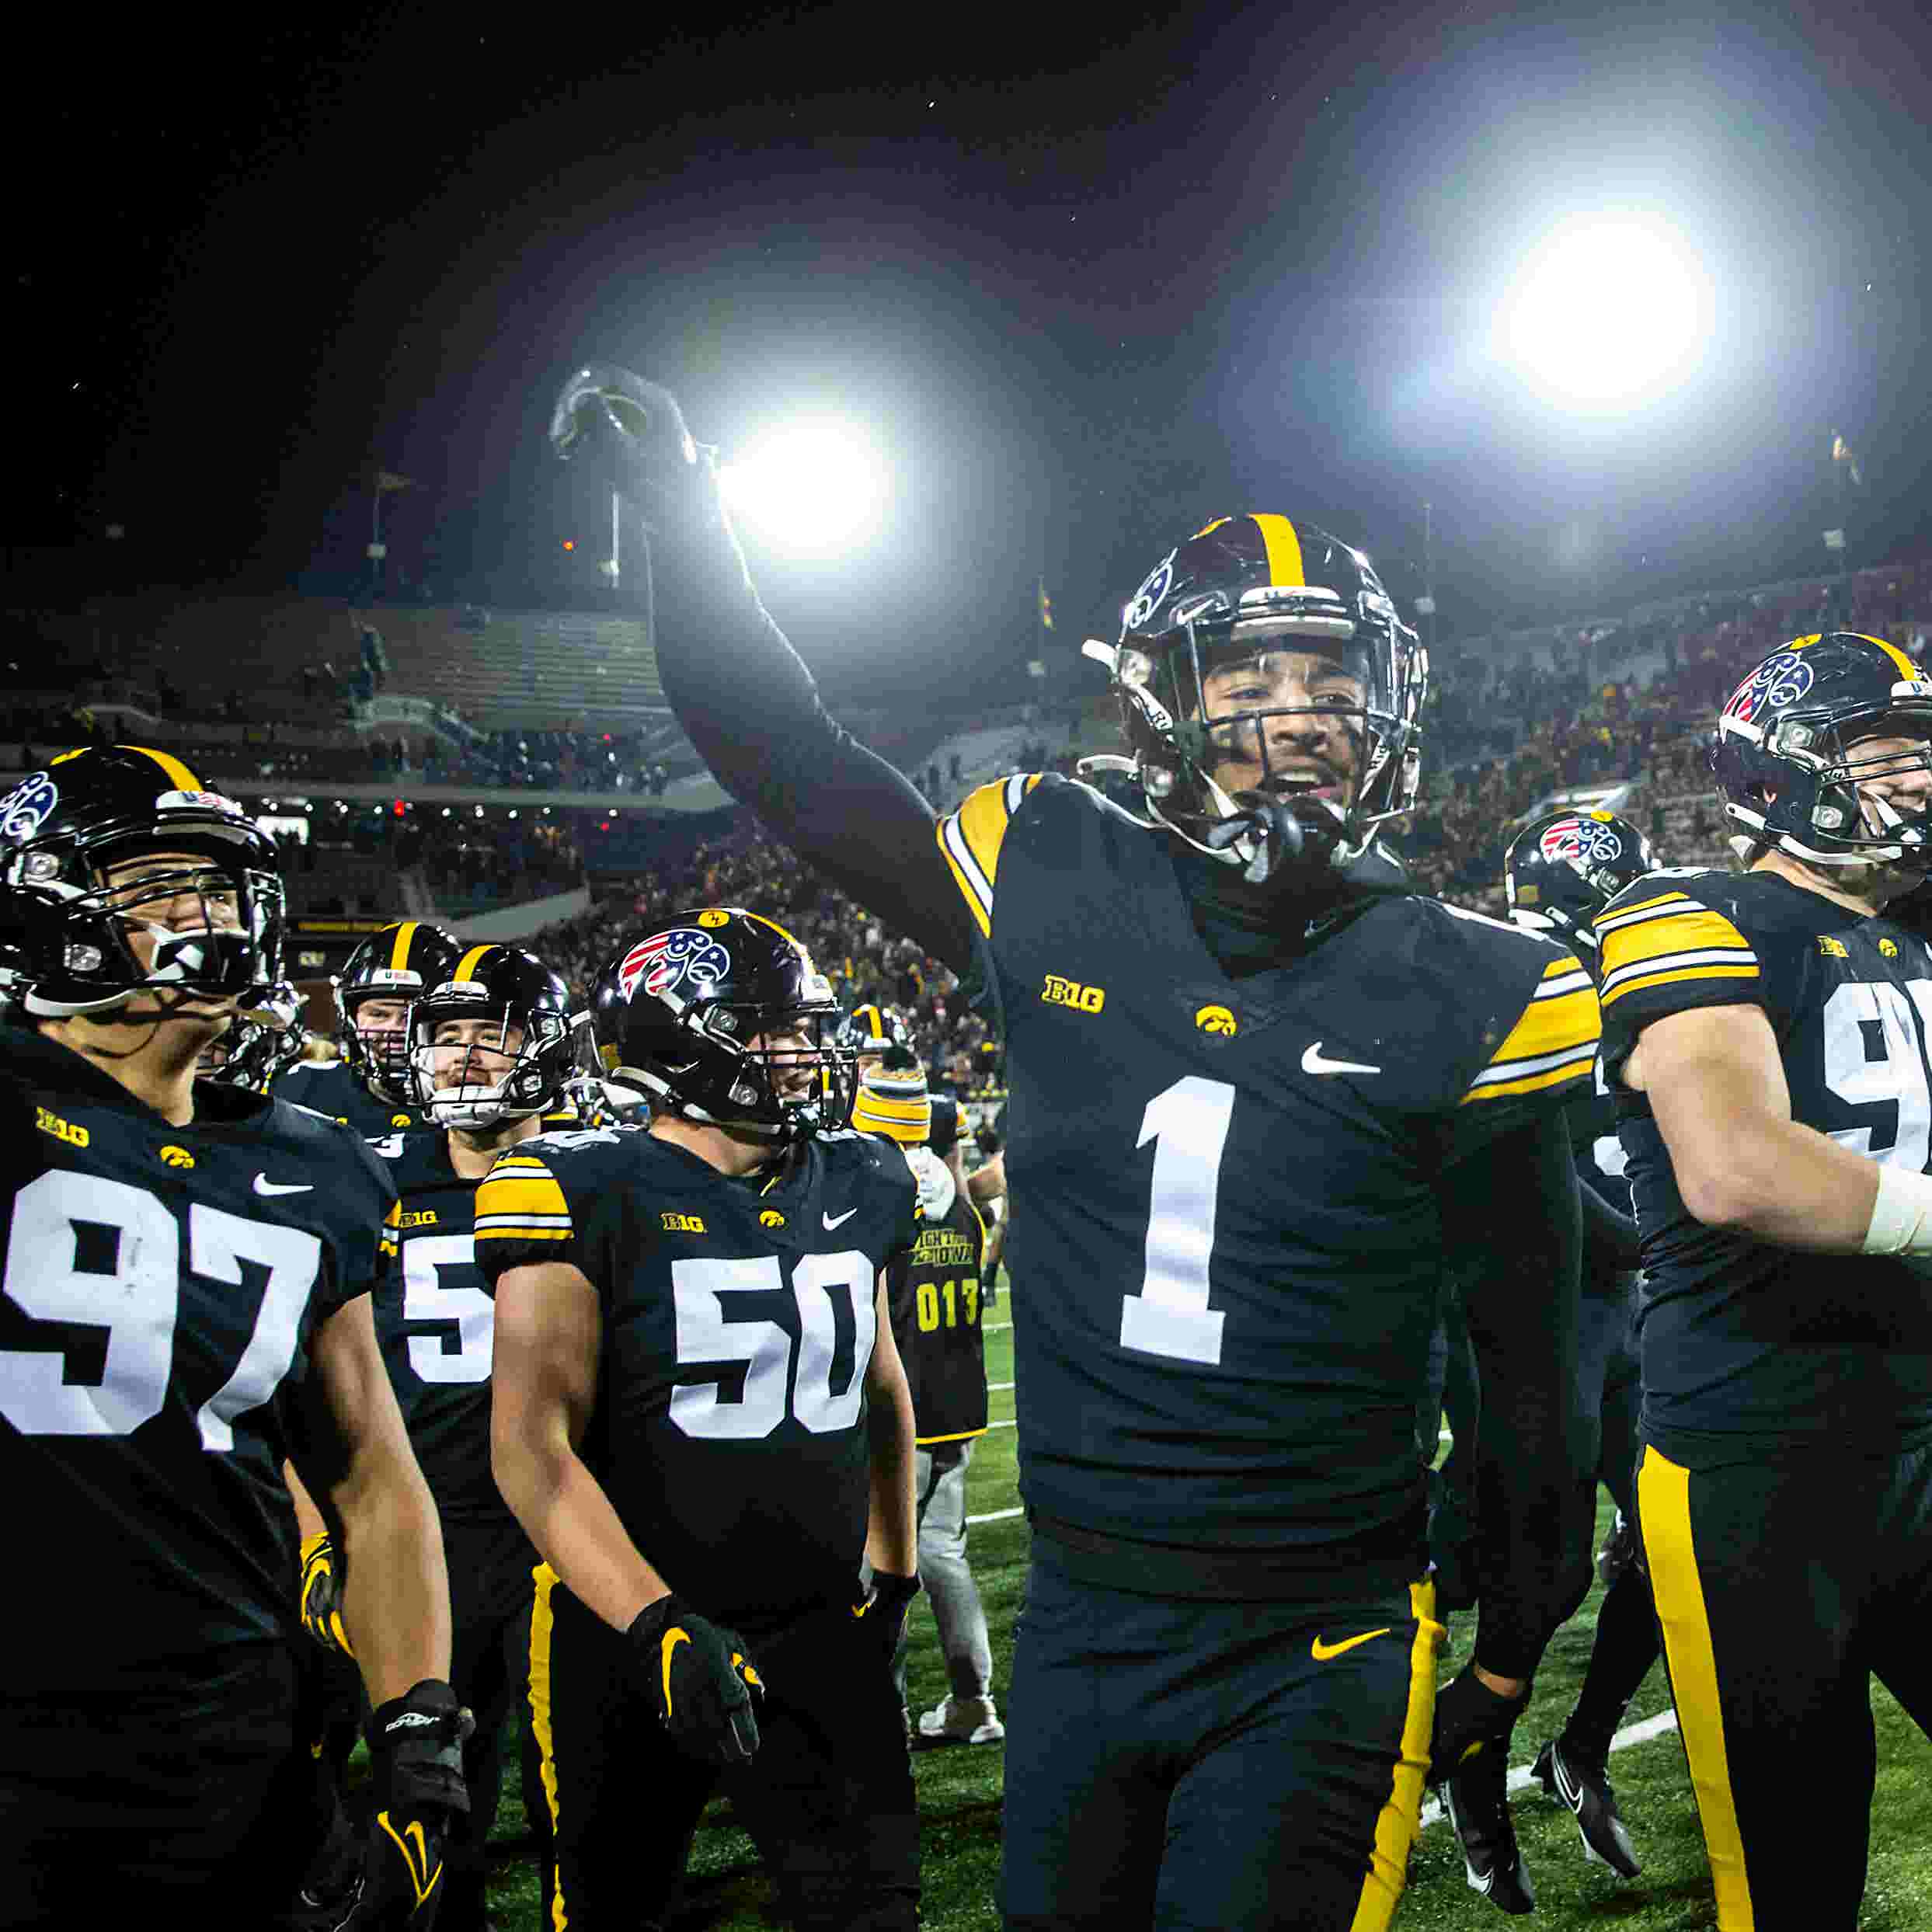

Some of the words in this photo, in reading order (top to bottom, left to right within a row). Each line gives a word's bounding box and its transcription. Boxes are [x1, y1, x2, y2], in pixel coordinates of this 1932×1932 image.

[0, 1168, 322, 1452] 97
[669, 1249, 876, 1439] 50
[1119, 1075, 1236, 1365] 1
